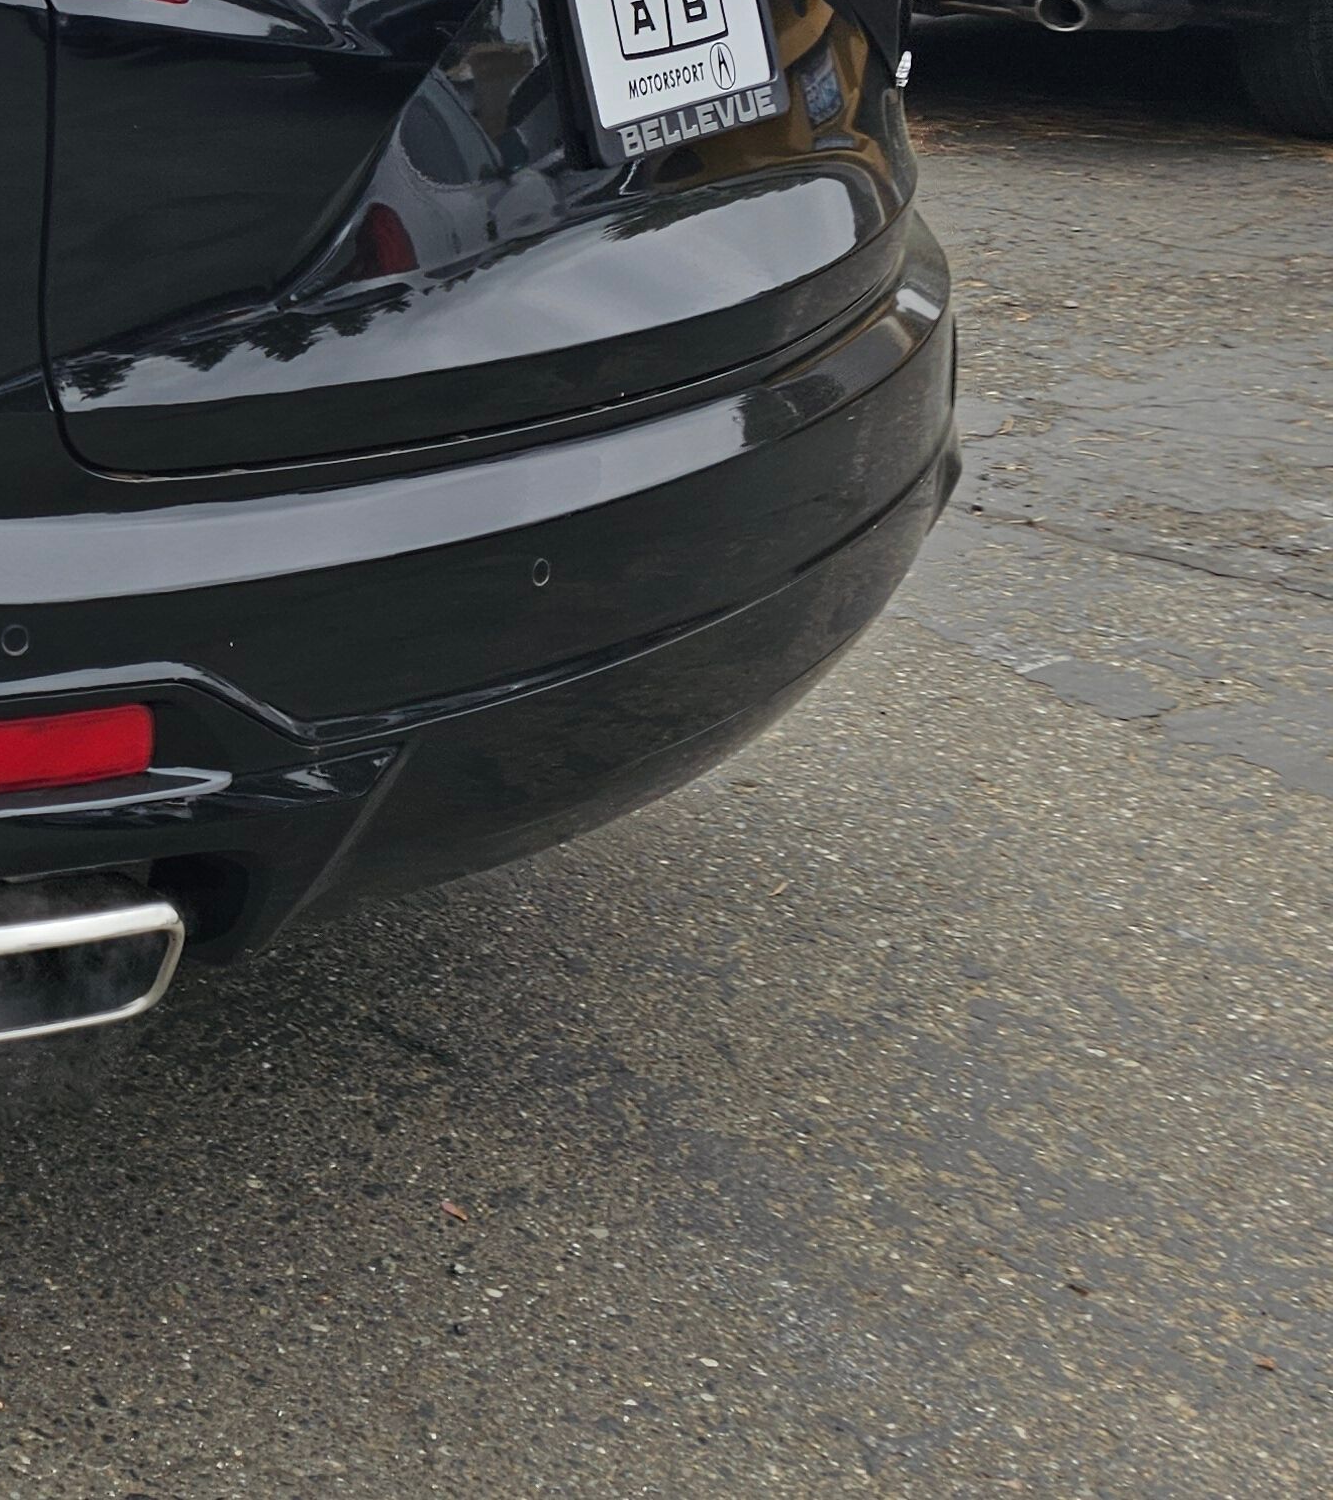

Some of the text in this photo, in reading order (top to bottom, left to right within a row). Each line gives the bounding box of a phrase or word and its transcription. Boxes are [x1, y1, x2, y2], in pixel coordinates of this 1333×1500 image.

[630, 0, 657, 35] A
[628, 62, 704, 99] MOTORSPORT
[617, 86, 777, 157] BELLEVUE
